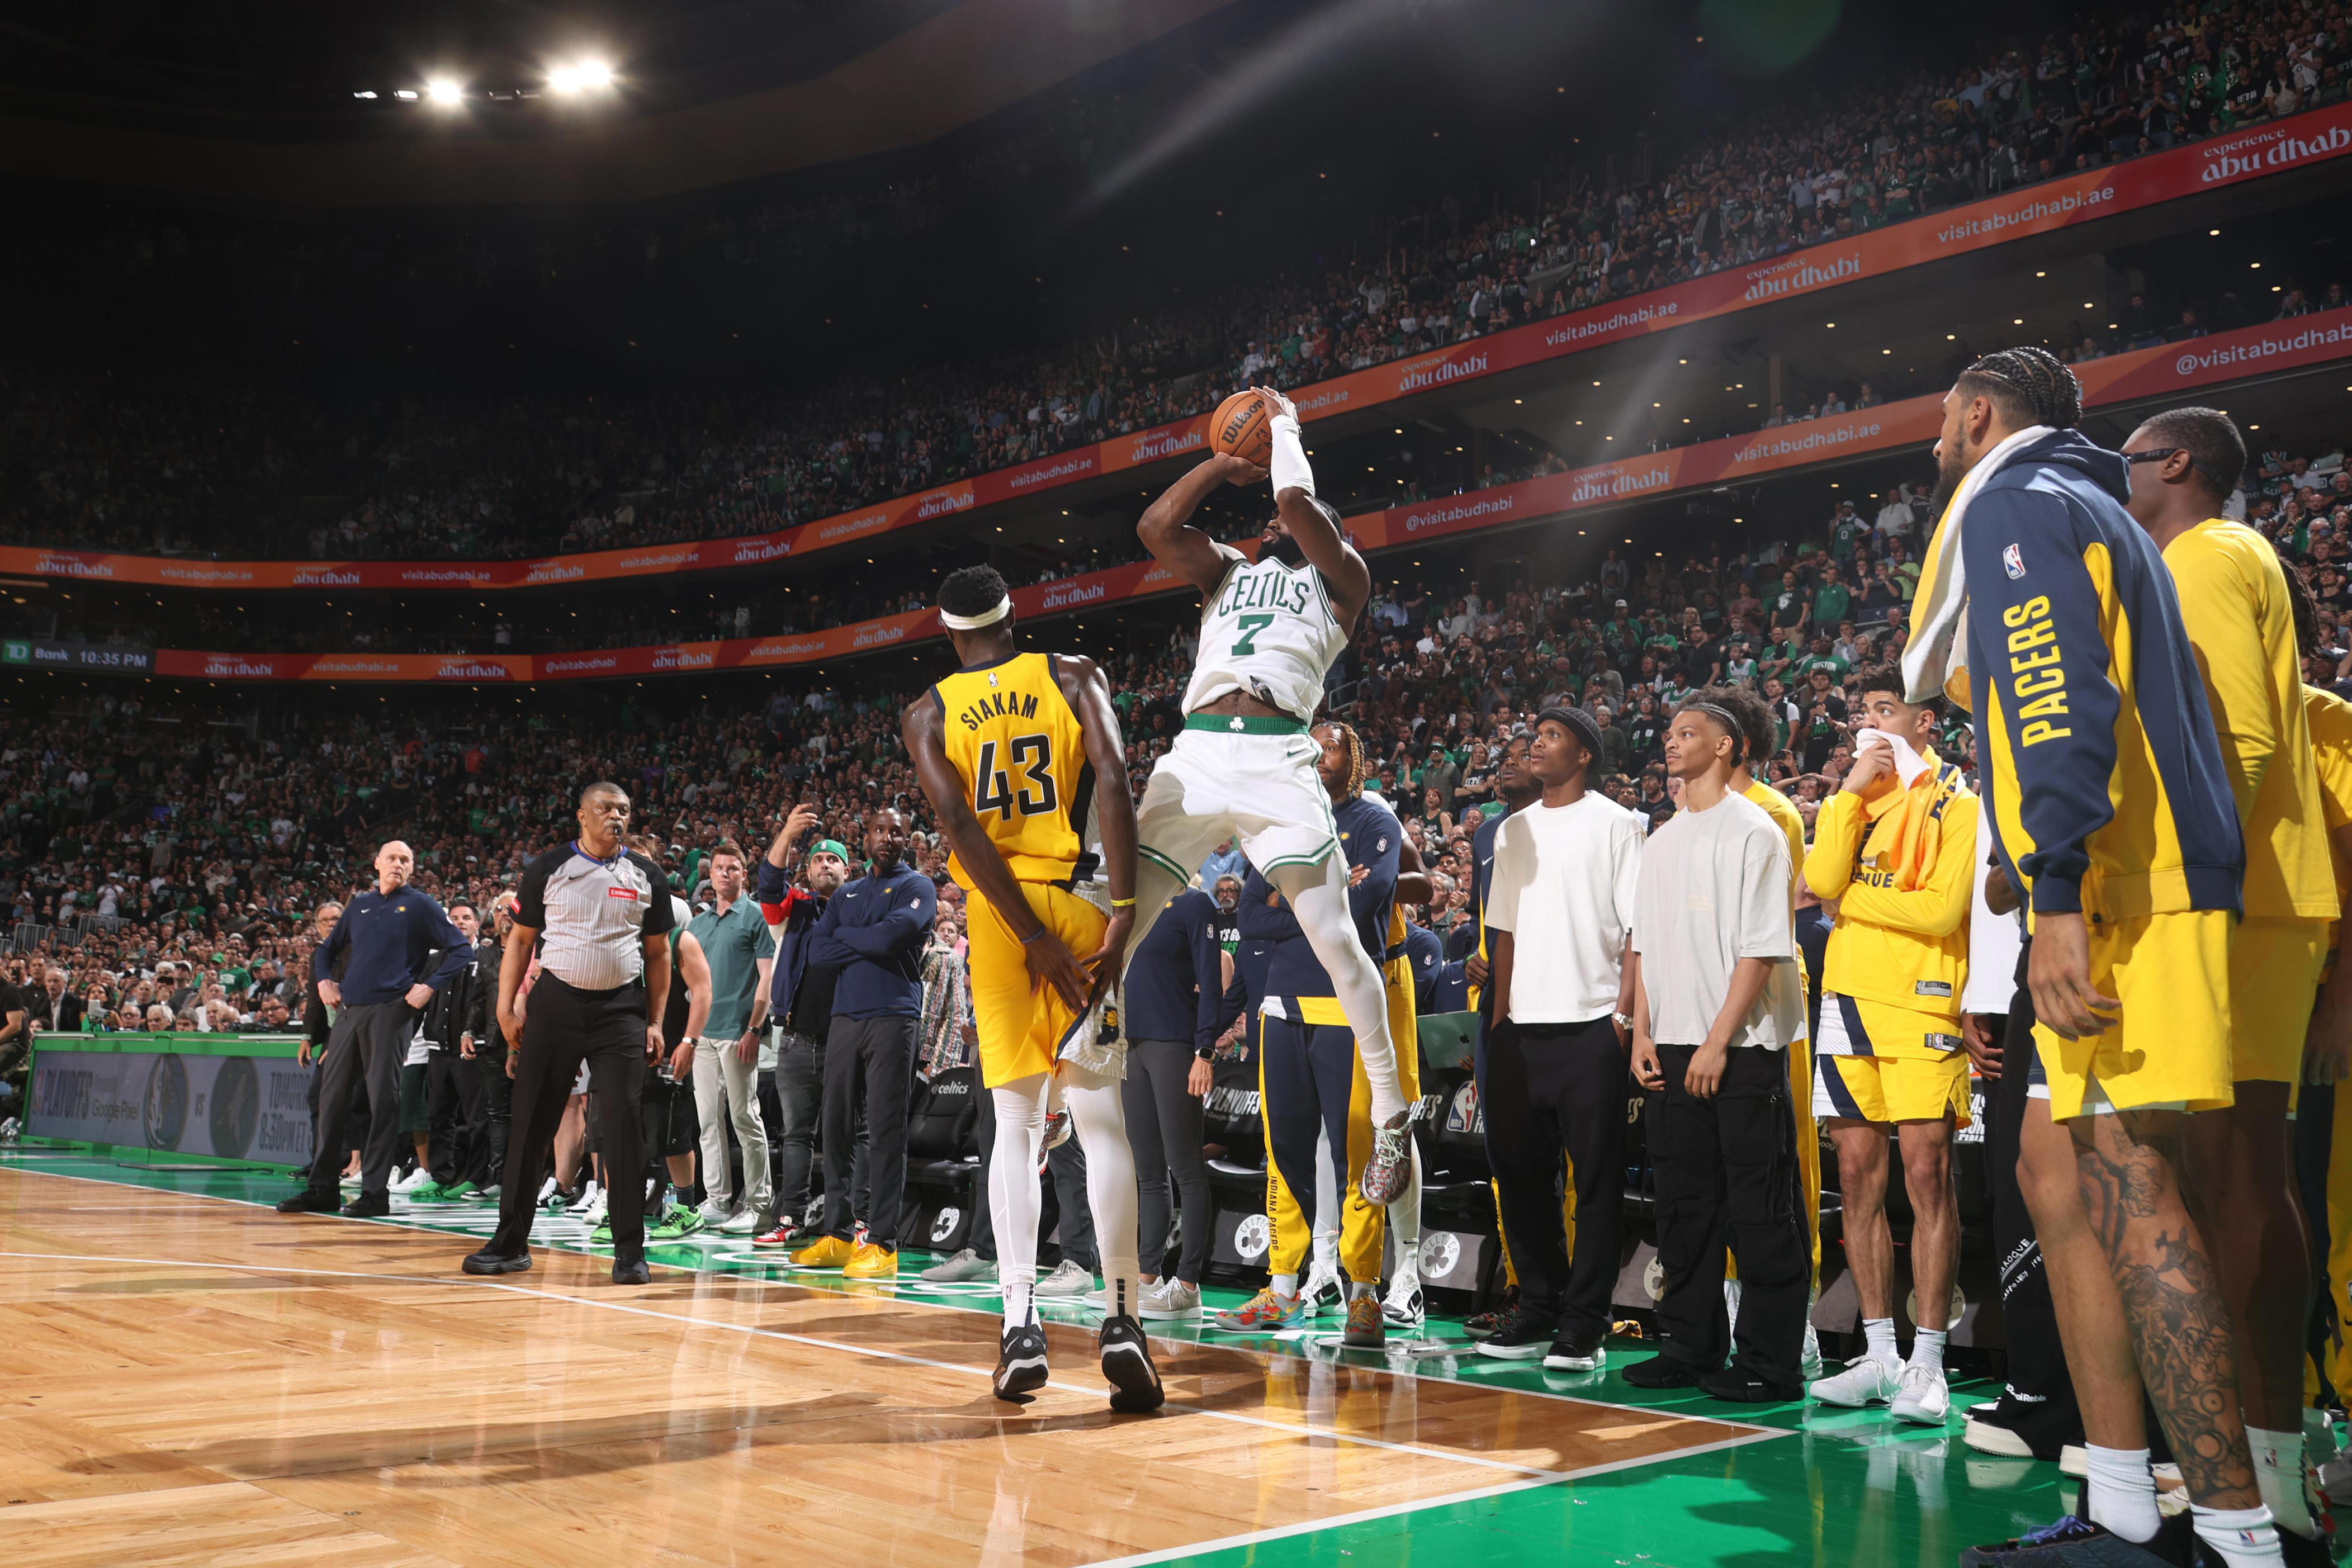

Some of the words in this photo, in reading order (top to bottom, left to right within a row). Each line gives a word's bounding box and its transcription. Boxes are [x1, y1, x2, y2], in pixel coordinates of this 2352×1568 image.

[2202, 153, 2260, 182] abu
[2266, 126, 2352, 165] dhab
[2204, 127, 2285, 157] experience
[1938, 187, 2114, 243] visitabudhabi.ae
[1744, 272, 1790, 301] abu
[1792, 253, 1861, 287] dhabi
[1747, 258, 1806, 280] experience
[1545, 301, 1677, 345] visitabudhabi.ae
[2176, 324, 2352, 375] @visitabudhab
[1399, 369, 1433, 392] abu
[1435, 352, 1488, 382] dhabi
[1296, 390, 1348, 414] dhabi.ae
[1222, 399, 1265, 444] Wilson
[1132, 438, 1160, 462] abu
[1161, 429, 1203, 456] dhabi
[1734, 423, 1881, 463] visitabudhabi.ae
[1011, 458, 1092, 488] visitabudhabi.ae
[1572, 480, 1608, 502] abu
[1612, 467, 1670, 496] dhabi
[918, 500, 940, 518] abu
[940, 490, 975, 511] dhabi
[1405, 495, 1512, 532] @visitabudhabi
[820, 515, 887, 539] visitabudhabi.ae
[735, 546, 760, 562] abu
[761, 539, 792, 558] dhabi
[293, 573, 319, 585] abu
[321, 571, 361, 585] dhabi
[401, 570, 491, 582] visitabudhabi.ae
[1043, 591, 1067, 609] abu
[1068, 582, 1105, 603] dhabi
[1218, 570, 1310, 618] CELTICS
[1232, 613, 1275, 656] 7
[6, 643, 28, 661] TD
[34, 647, 70, 662] Bank
[79, 650, 121, 667] 10:35
[123, 652, 148, 668] PM
[204, 661, 232, 675] abu
[233, 662, 273, 676] dhabi
[438, 664, 466, 677] abu
[466, 664, 505, 678] dhabi
[2003, 595, 2072, 748] PACERS
[960, 691, 1039, 731] SIAKAM
[976, 733, 1057, 822] 43
[931, 1081, 969, 1095] @celtics
[1450, 1118, 1463, 1129] NBA
[1268, 1176, 1278, 1212] INDIANA
[1269, 1217, 1279, 1251] PACERS
[1423, 1234, 1458, 1254] CELTICS
[2000, 1238, 2031, 1276] AROQUE
